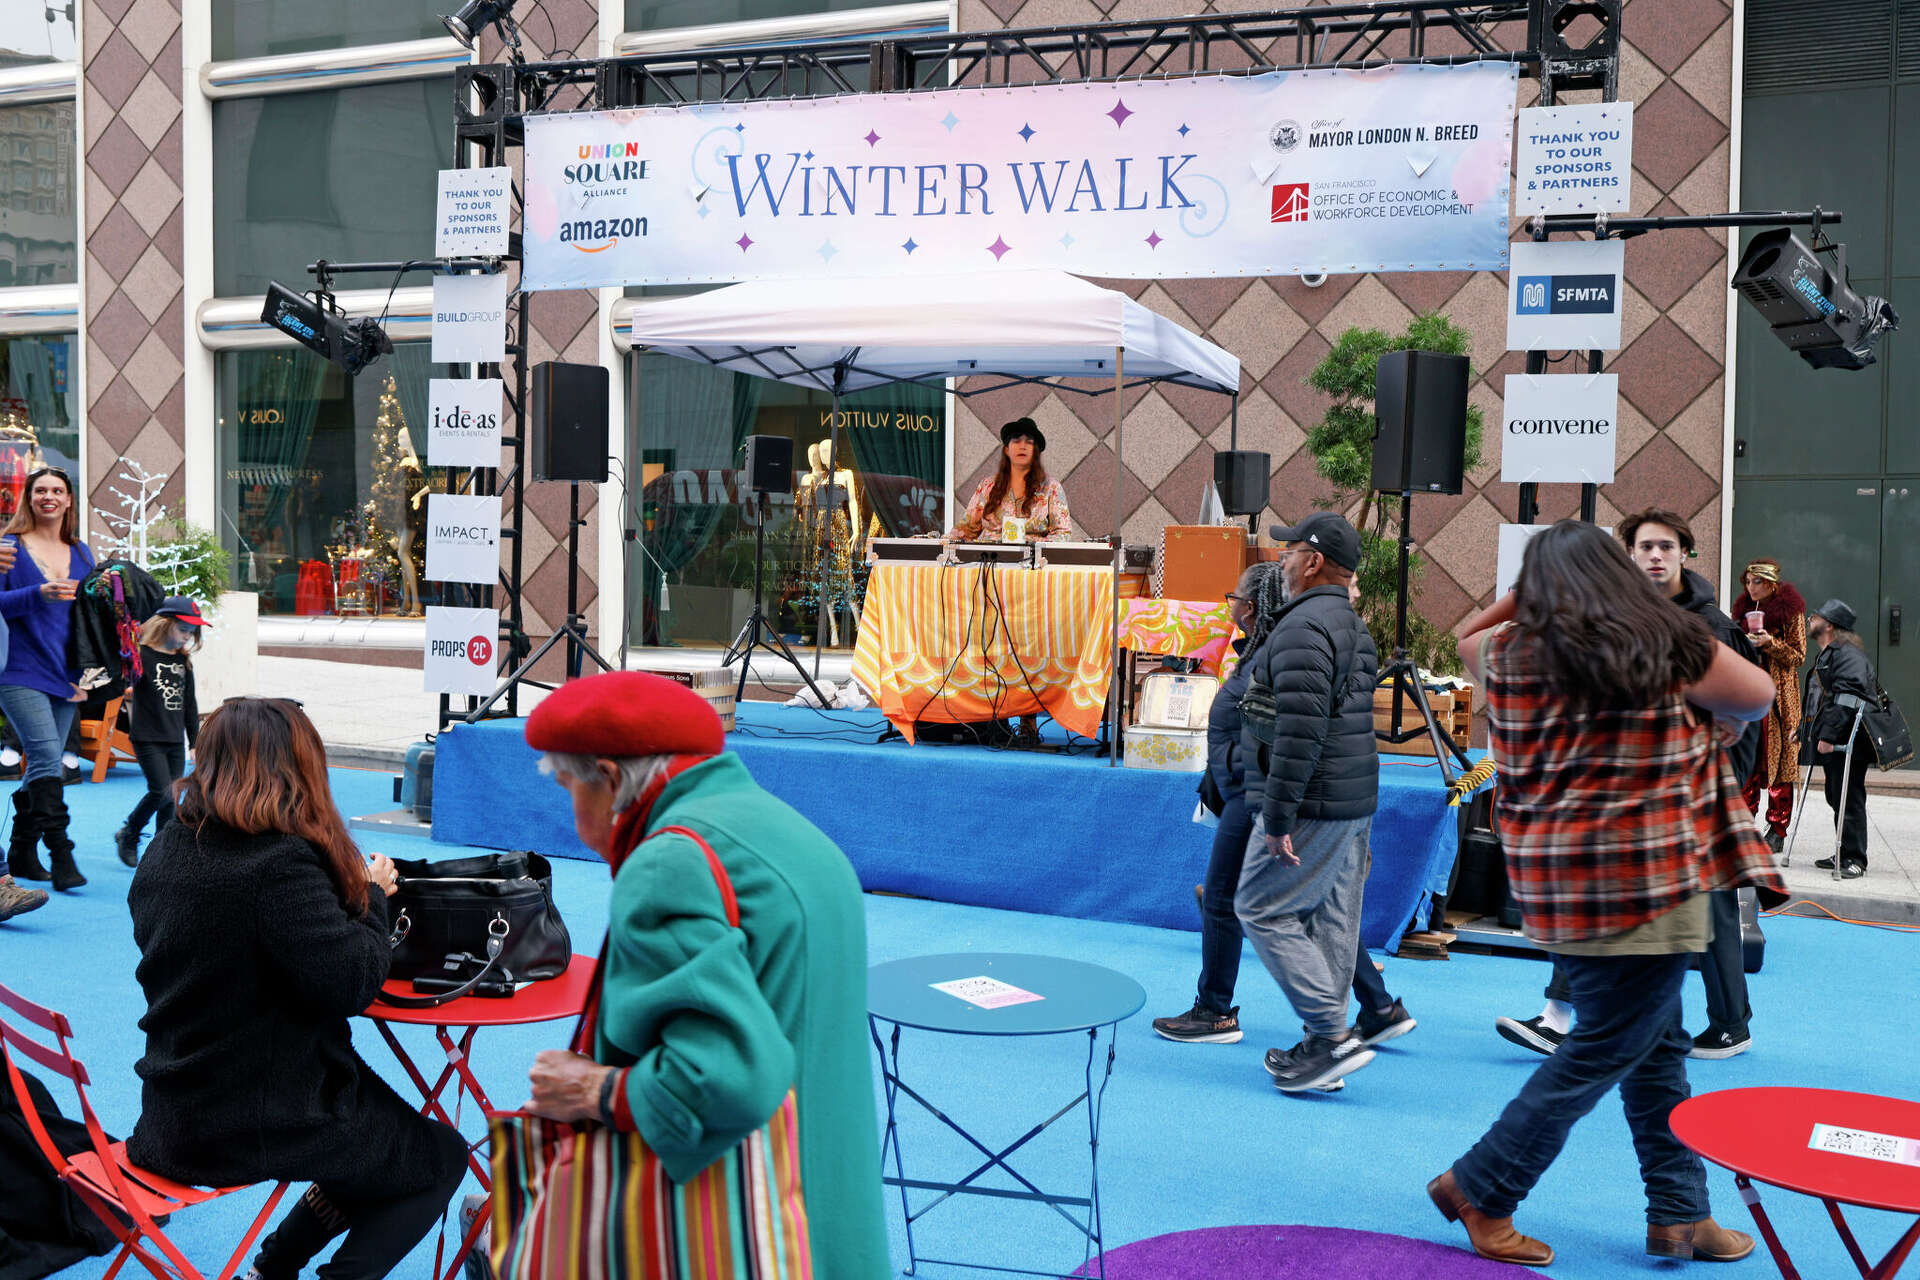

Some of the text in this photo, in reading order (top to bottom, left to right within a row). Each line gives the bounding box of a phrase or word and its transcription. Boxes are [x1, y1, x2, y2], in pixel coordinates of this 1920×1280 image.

[1309, 131, 1354, 149] MAYOR
[1357, 127, 1412, 146] LONDON
[1415, 127, 1429, 142] N.
[1434, 124, 1479, 141] BREED
[1529, 130, 1620, 145] THANK YOU
[578, 141, 639, 160] UNION
[1545, 146, 1602, 159] TO OUR
[563, 160, 652, 188] SQUARE
[1535, 161, 1612, 175] SPONSORS
[724, 149, 1198, 218] WINTER WALK
[1314, 179, 1376, 190] SAN FRANCISCO
[1527, 176, 1619, 190] & PARTNERS
[445, 188, 503, 199] THANK YOU
[583, 187, 628, 198] ALLIANCE
[1313, 189, 1459, 206] OFFICE OF ECONOMIC &
[455, 201, 491, 211] TO OUR
[1313, 203, 1474, 221] WORKFORCE DEVELOPMENT
[448, 213, 497, 223] SPONSORS
[443, 225, 502, 235] & PARTNERS
[560, 216, 648, 242] amazon
[1557, 287, 1609, 302] SFMTA
[437, 311, 502, 323] BUILDGROUP
[1509, 418, 1610, 435] convene
[439, 430, 459, 438] EVENTS
[467, 430, 491, 438] RENTALS
[434, 525, 489, 540] IMPACT
[431, 639, 487, 660] PROPS 2C
[1214, 1018, 1237, 1031] HOKA
